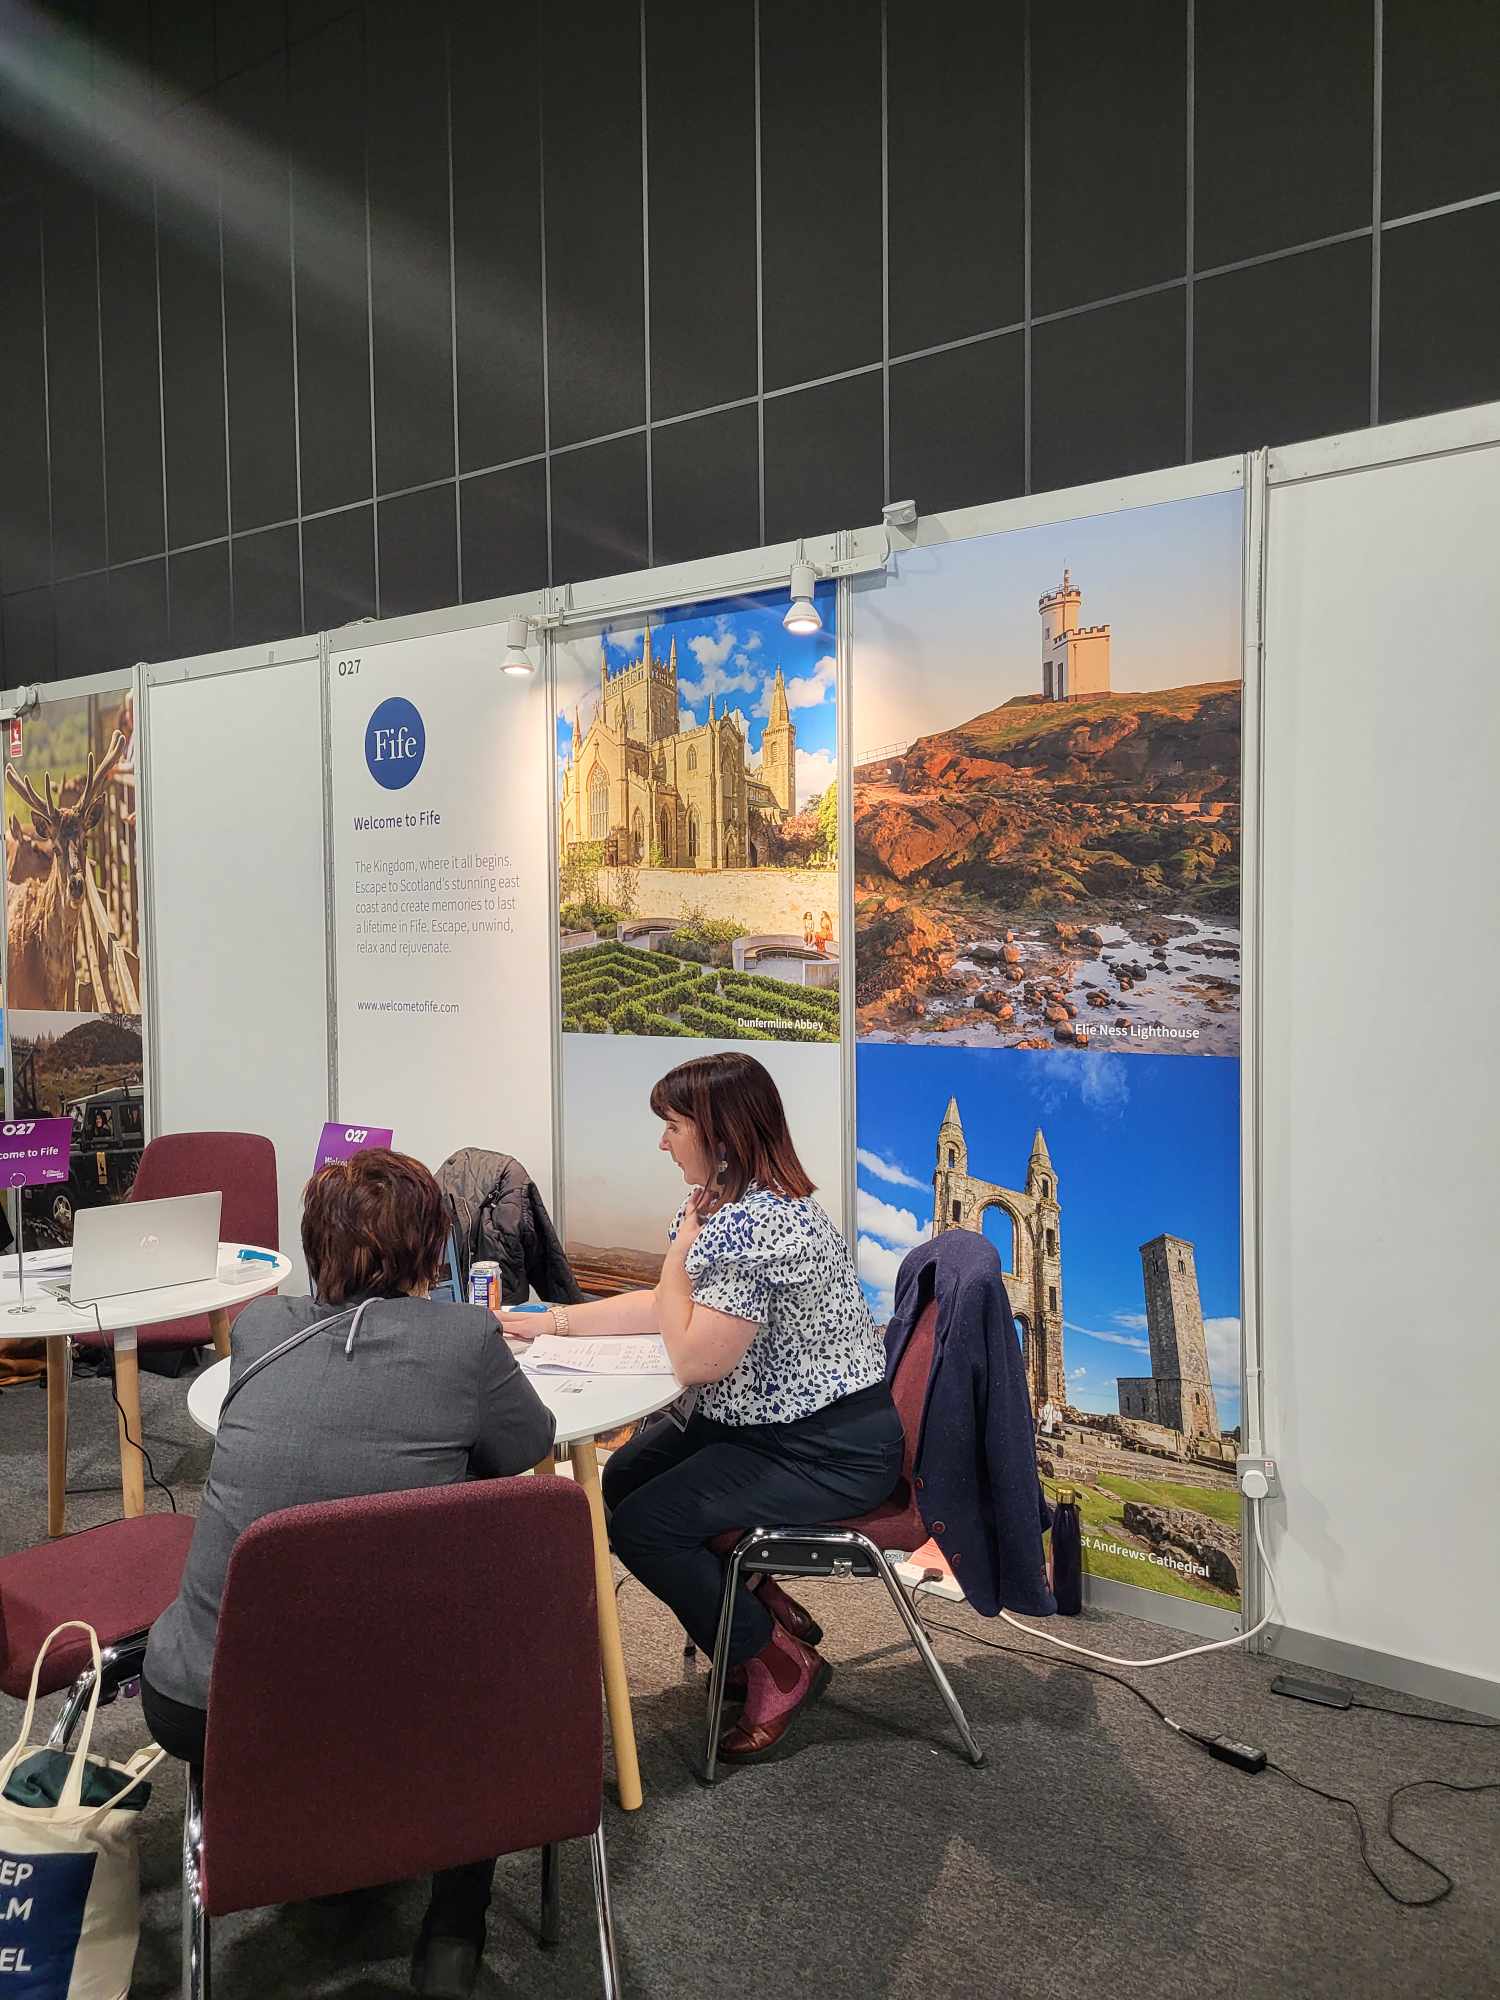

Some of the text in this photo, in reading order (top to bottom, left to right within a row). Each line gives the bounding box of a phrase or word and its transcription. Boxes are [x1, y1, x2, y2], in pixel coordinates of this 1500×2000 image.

[374, 727, 417, 761] Fife
[354, 810, 441, 831] Welcome to Fife
[355, 859, 372, 873] The
[373, 858, 418, 876] Kingdom,
[420, 856, 450, 871] where
[451, 855, 459, 869] it
[460, 853, 473, 869] all
[355, 880, 387, 896] Escape
[388, 879, 399, 893] to
[452, 877, 497, 892] stunning
[498, 874, 520, 889] east
[355, 896, 517, 914] coast and create memories to last
[363, 919, 397, 934] lifetime
[399, 919, 409, 934] in
[431, 918, 470, 936] Escape,
[472, 917, 514, 934] unwind,
[356, 939, 452, 958] relax and rejuvenate.
[357, 999, 460, 1013] www.welcometofife.com
[737, 1017, 824, 1032] Dunfermline Abbey
[1075, 1023, 1200, 1040] Elie Ness Lighthouse
[27, 1149, 38, 1158] to
[40, 1146, 59, 1157] Fife
[1080, 1535, 1210, 1578] St Andrews Cathedral
